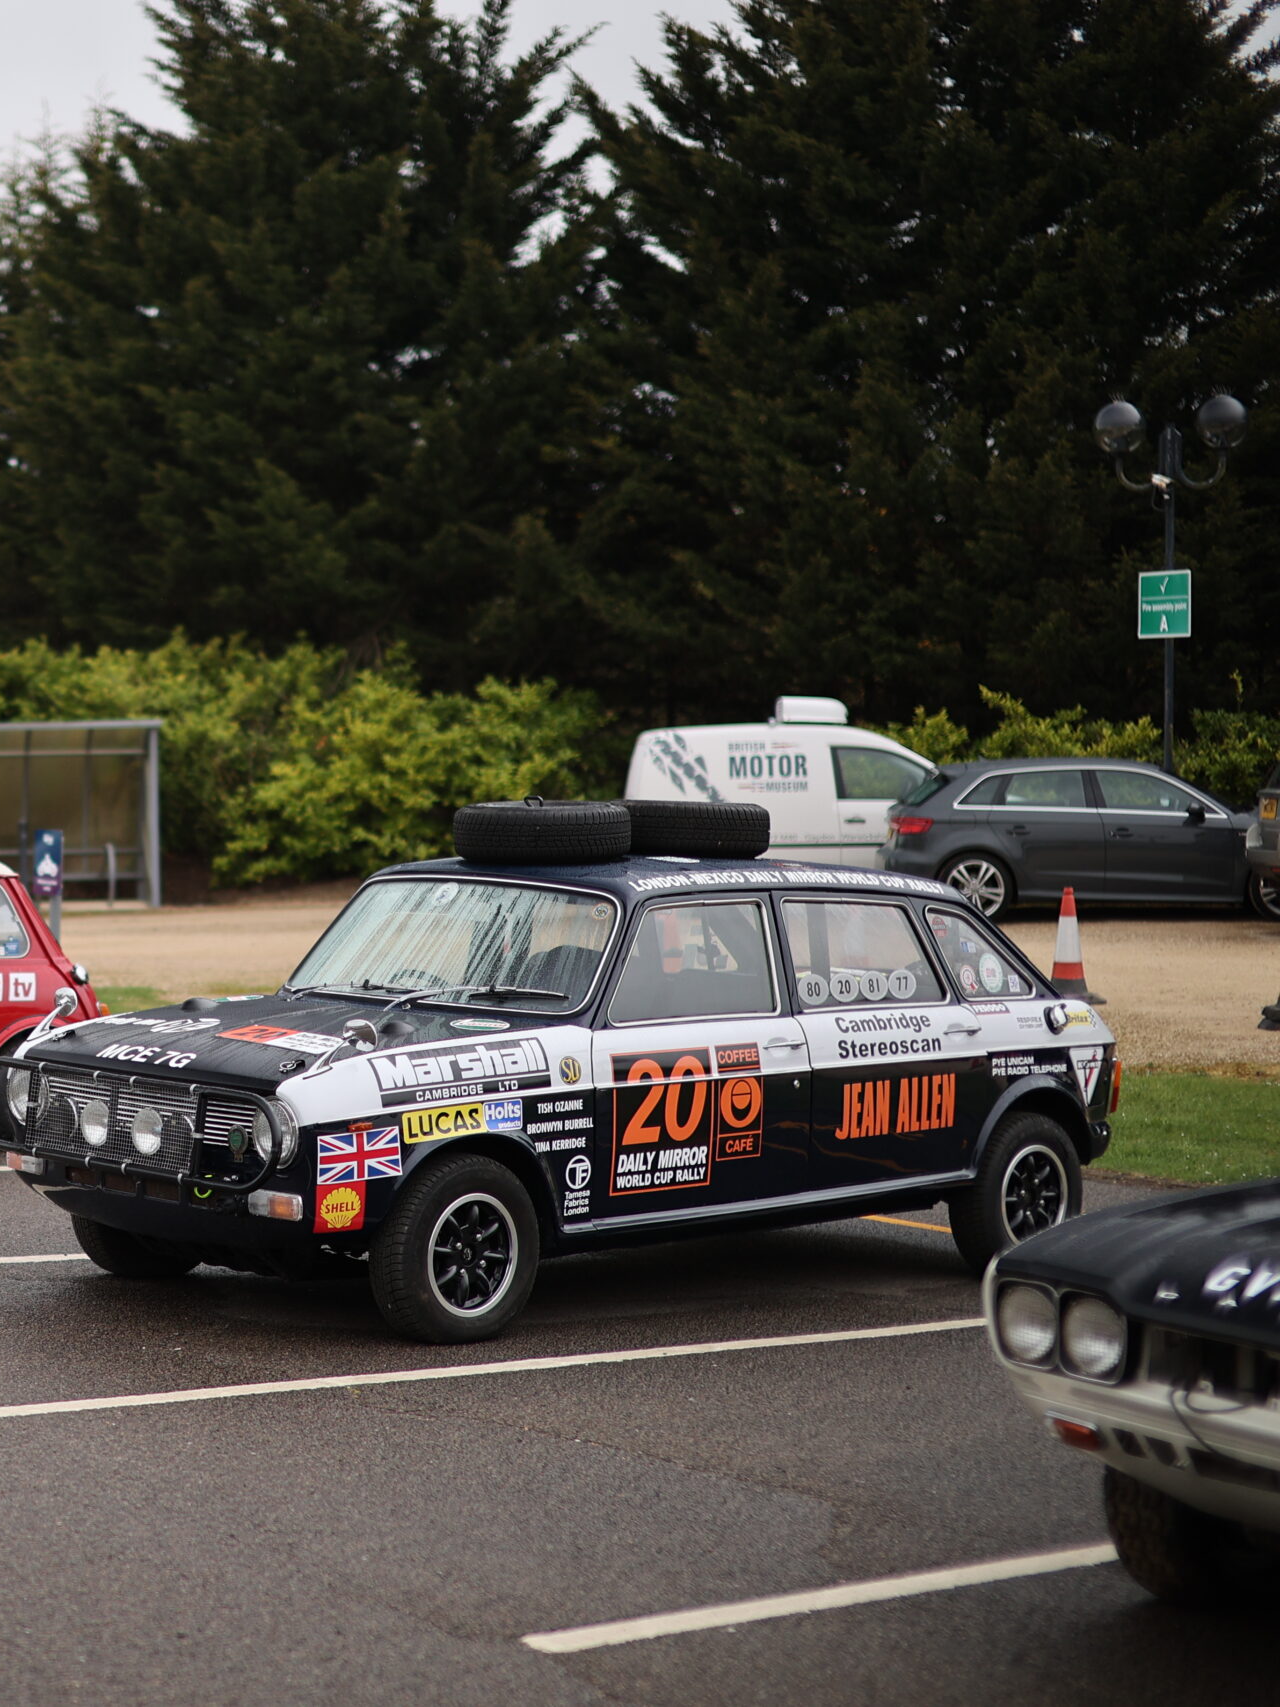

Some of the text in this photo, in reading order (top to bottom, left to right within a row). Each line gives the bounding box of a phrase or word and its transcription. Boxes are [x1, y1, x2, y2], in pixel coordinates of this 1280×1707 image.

[1160, 614, 1169, 632] A
[728, 742, 766, 752] BRITISH
[728, 754, 808, 778] MOTOR
[765, 781, 808, 792] MUSEUM
[629, 871, 945, 895] LONDON-MEXICO DAILY MIRROR WORLD CUP RALLY
[12, 977, 33, 998] tv
[807, 982, 821, 997] 80
[838, 979, 851, 994] 20
[868, 977, 880, 993] 81
[895, 976, 908, 991] 77
[834, 1013, 932, 1033] Cambridge
[95, 1043, 198, 1069] MCE 7G
[717, 1048, 759, 1064] COFFEE
[838, 1037, 942, 1060] Stereoscan
[372, 1039, 547, 1090] Marshall
[991, 1056, 1035, 1067] PYE UNICAM
[991, 1064, 1068, 1077] PYE RADIO TELEPHONE
[415, 1081, 519, 1102] CAMBRIDGE LTD
[622, 1055, 708, 1146] 20
[485, 1102, 521, 1120] Holts
[537, 1099, 584, 1115] TISH OZANNE
[834, 1073, 956, 1140] JEAN ALLEN
[407, 1108, 482, 1139] LUCAS
[497, 1121, 521, 1129] products
[526, 1117, 594, 1135] BRONWYN BURRELL
[534, 1137, 587, 1153] TINA KERRIDGE
[725, 1134, 754, 1154] CAFÉ
[617, 1146, 708, 1174] DAILY MIRROR
[616, 1166, 706, 1189] WORLD CUP RALLY
[564, 1189, 591, 1200] Tamesa
[564, 1198, 589, 1208] Fabrics
[324, 1201, 357, 1214] SHELL
[563, 1205, 590, 1217] London
